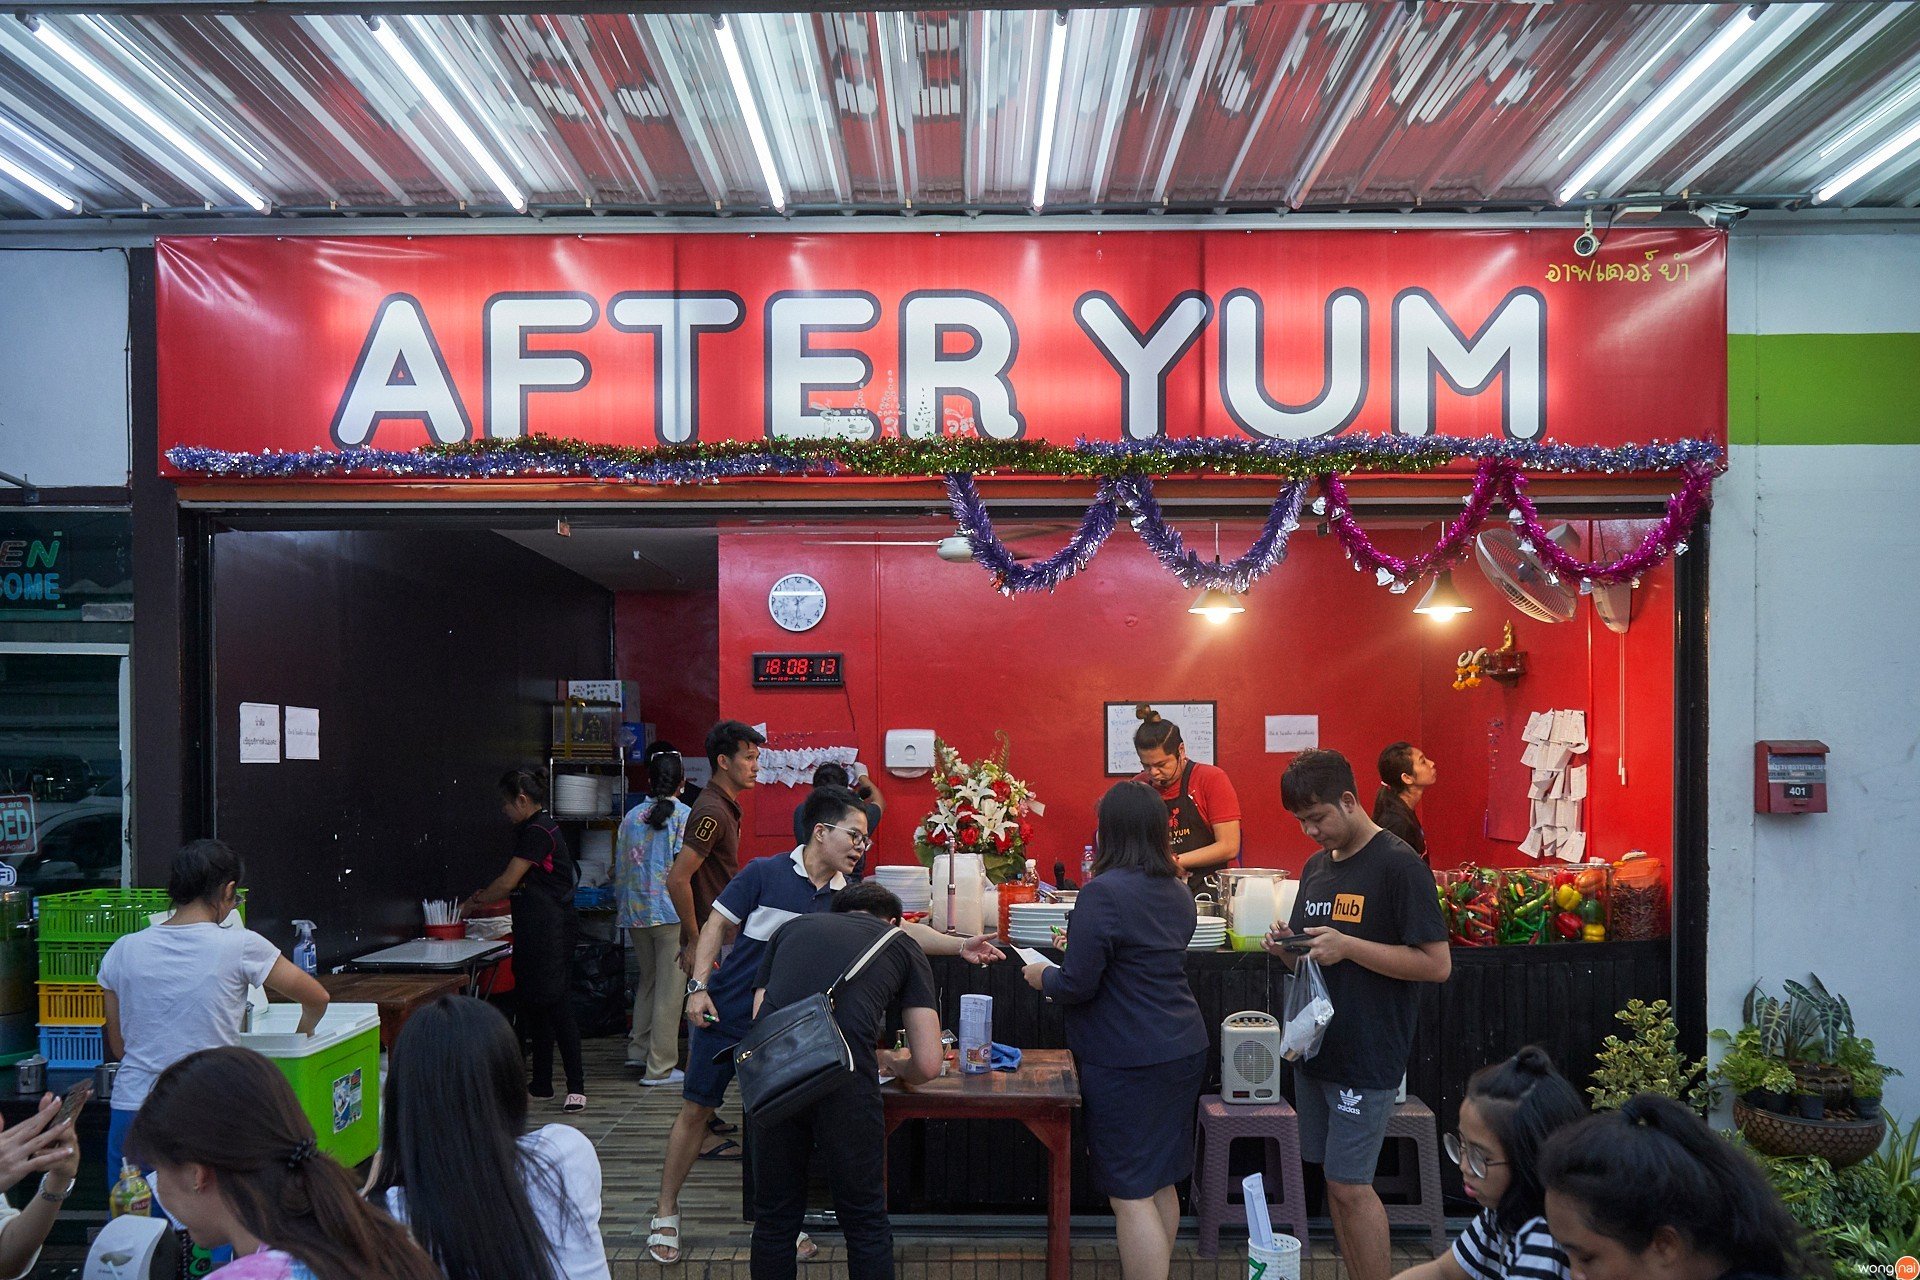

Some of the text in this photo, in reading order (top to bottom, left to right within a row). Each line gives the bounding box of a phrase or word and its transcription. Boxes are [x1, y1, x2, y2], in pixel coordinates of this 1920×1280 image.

[1659, 253, 1690, 282] ยำ
[330, 286, 1547, 448] AFTER YUM
[0, 572, 61, 600] OME
[1789, 787, 1806, 796] 401
[695, 816, 717, 842] 8
[1337, 1104, 1360, 1115] adidas
